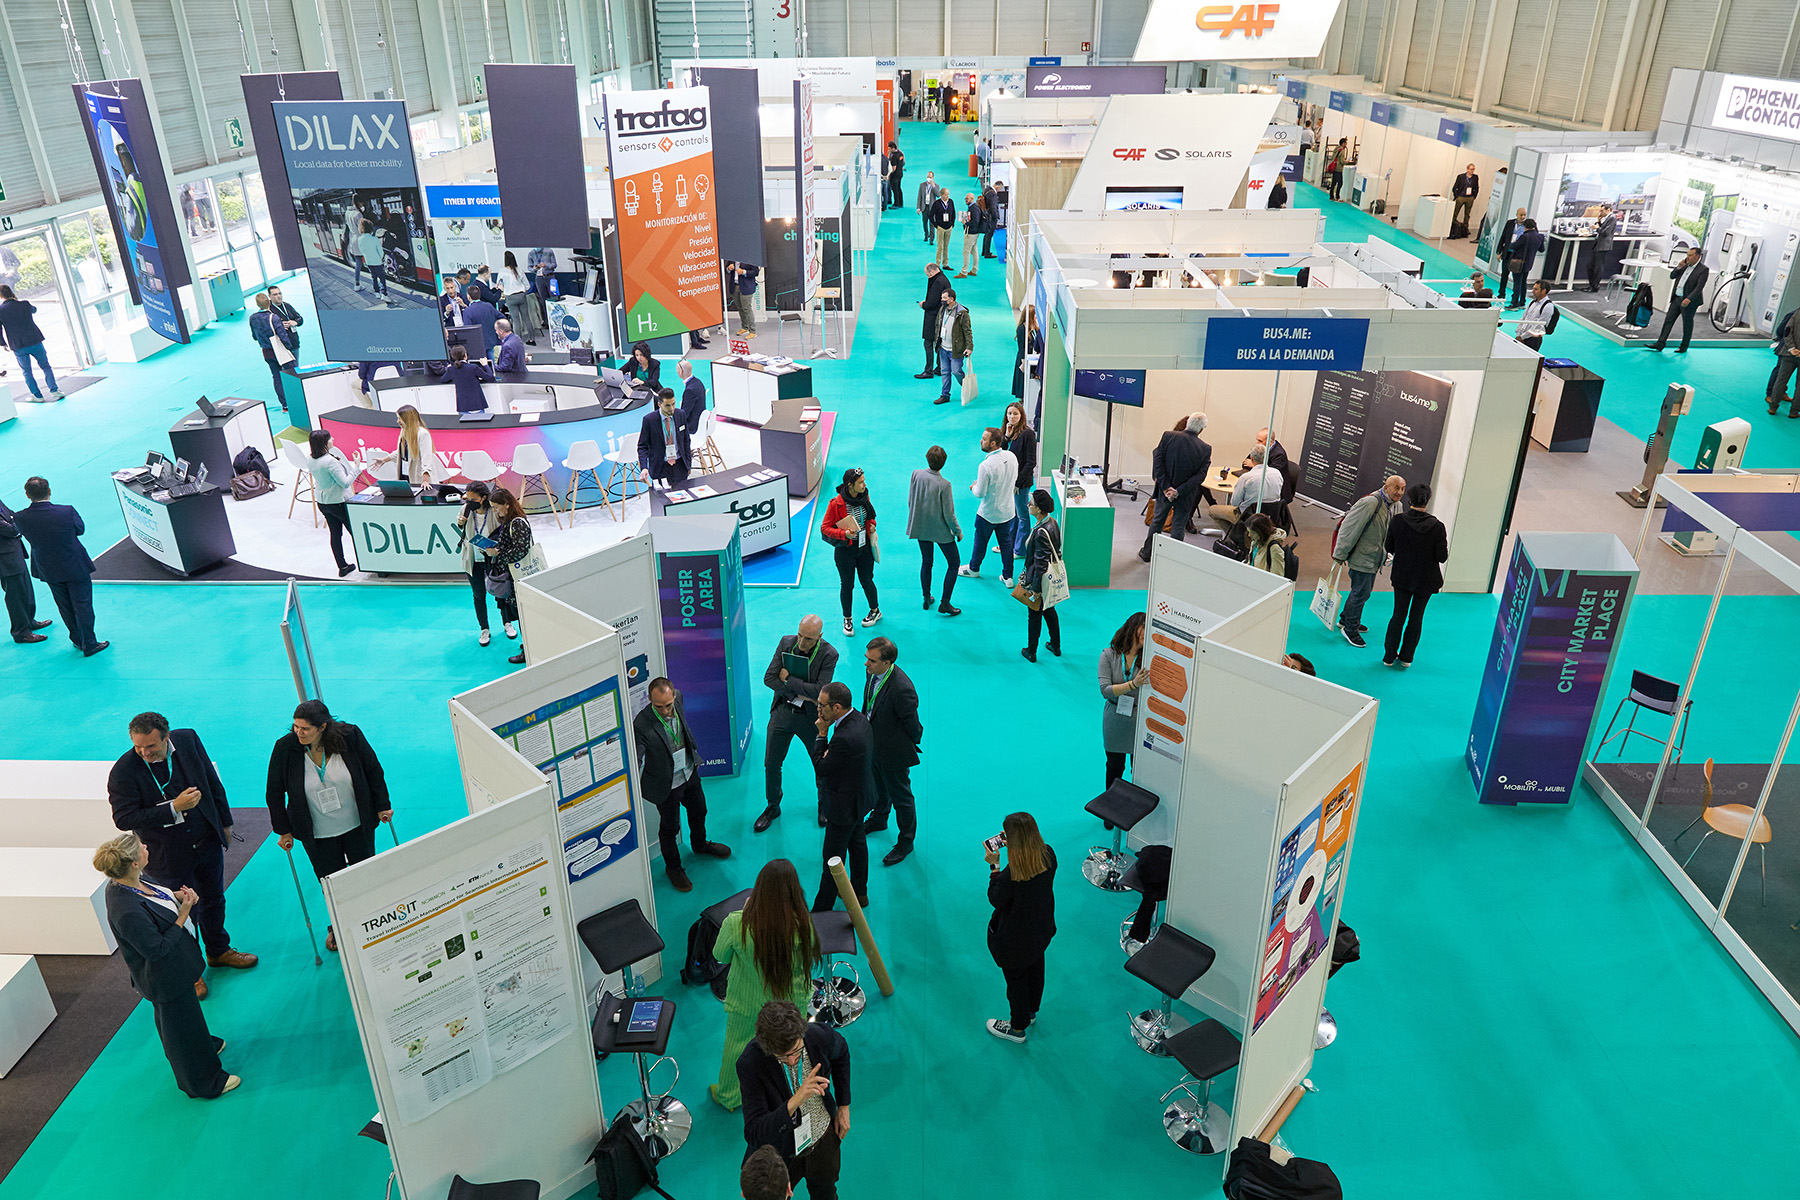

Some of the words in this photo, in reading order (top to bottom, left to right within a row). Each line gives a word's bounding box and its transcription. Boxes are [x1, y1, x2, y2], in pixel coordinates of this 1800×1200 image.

[776, 0, 791, 19] 3
[1196, 4, 1280, 39] CAF
[614, 99, 707, 138] trafag
[285, 113, 399, 151] DILAX
[618, 142, 657, 152] sensors
[674, 134, 709, 147] controls
[1112, 148, 1147, 161] CAF
[1185, 150, 1232, 158] SOLARIS
[294, 160, 315, 169] Local
[316, 160, 332, 168] data
[333, 160, 344, 168] for
[345, 160, 368, 168] better
[369, 159, 404, 169] mobility.
[467, 197, 475, 205] BY
[645, 212, 697, 229] MONITORIZACIÓN
[698, 212, 708, 220] DE:
[694, 223, 711, 234] Nivel
[689, 235, 713, 247] Presión
[683, 246, 716, 260] Velocidad
[678, 259, 717, 273] Vibraciones
[678, 271, 718, 286] Movimiento
[677, 283, 719, 298] Temperatura
[1263, 327, 1312, 340] BUS4.ME:
[1236, 348, 1257, 360] BUS
[1259, 348, 1267, 360] A
[1269, 349, 1281, 360] LA
[1284, 349, 1335, 361] DEMANDA
[742, 522, 777, 539] controls
[698, 568, 715, 610] AREA
[678, 569, 696, 628] POSTER
[1512, 575, 1528, 629] PLACE
[1173, 610, 1202, 625] HARMONY
[1496, 635, 1507, 671] CITY
[1506, 566, 1524, 633] MARKET
[1567, 588, 1598, 653] MARKET
[1592, 589, 1620, 641] PLACE
[1557, 658, 1579, 693] CITY
[366, 931, 384, 942] Travel
[385, 916, 419, 934] Information
[420, 897, 456, 918] Management
[464, 882, 490, 896] Seamless
[490, 869, 519, 883] Intermodal
[519, 856, 544, 871] Transport
[361, 900, 417, 932] TRANSIT
